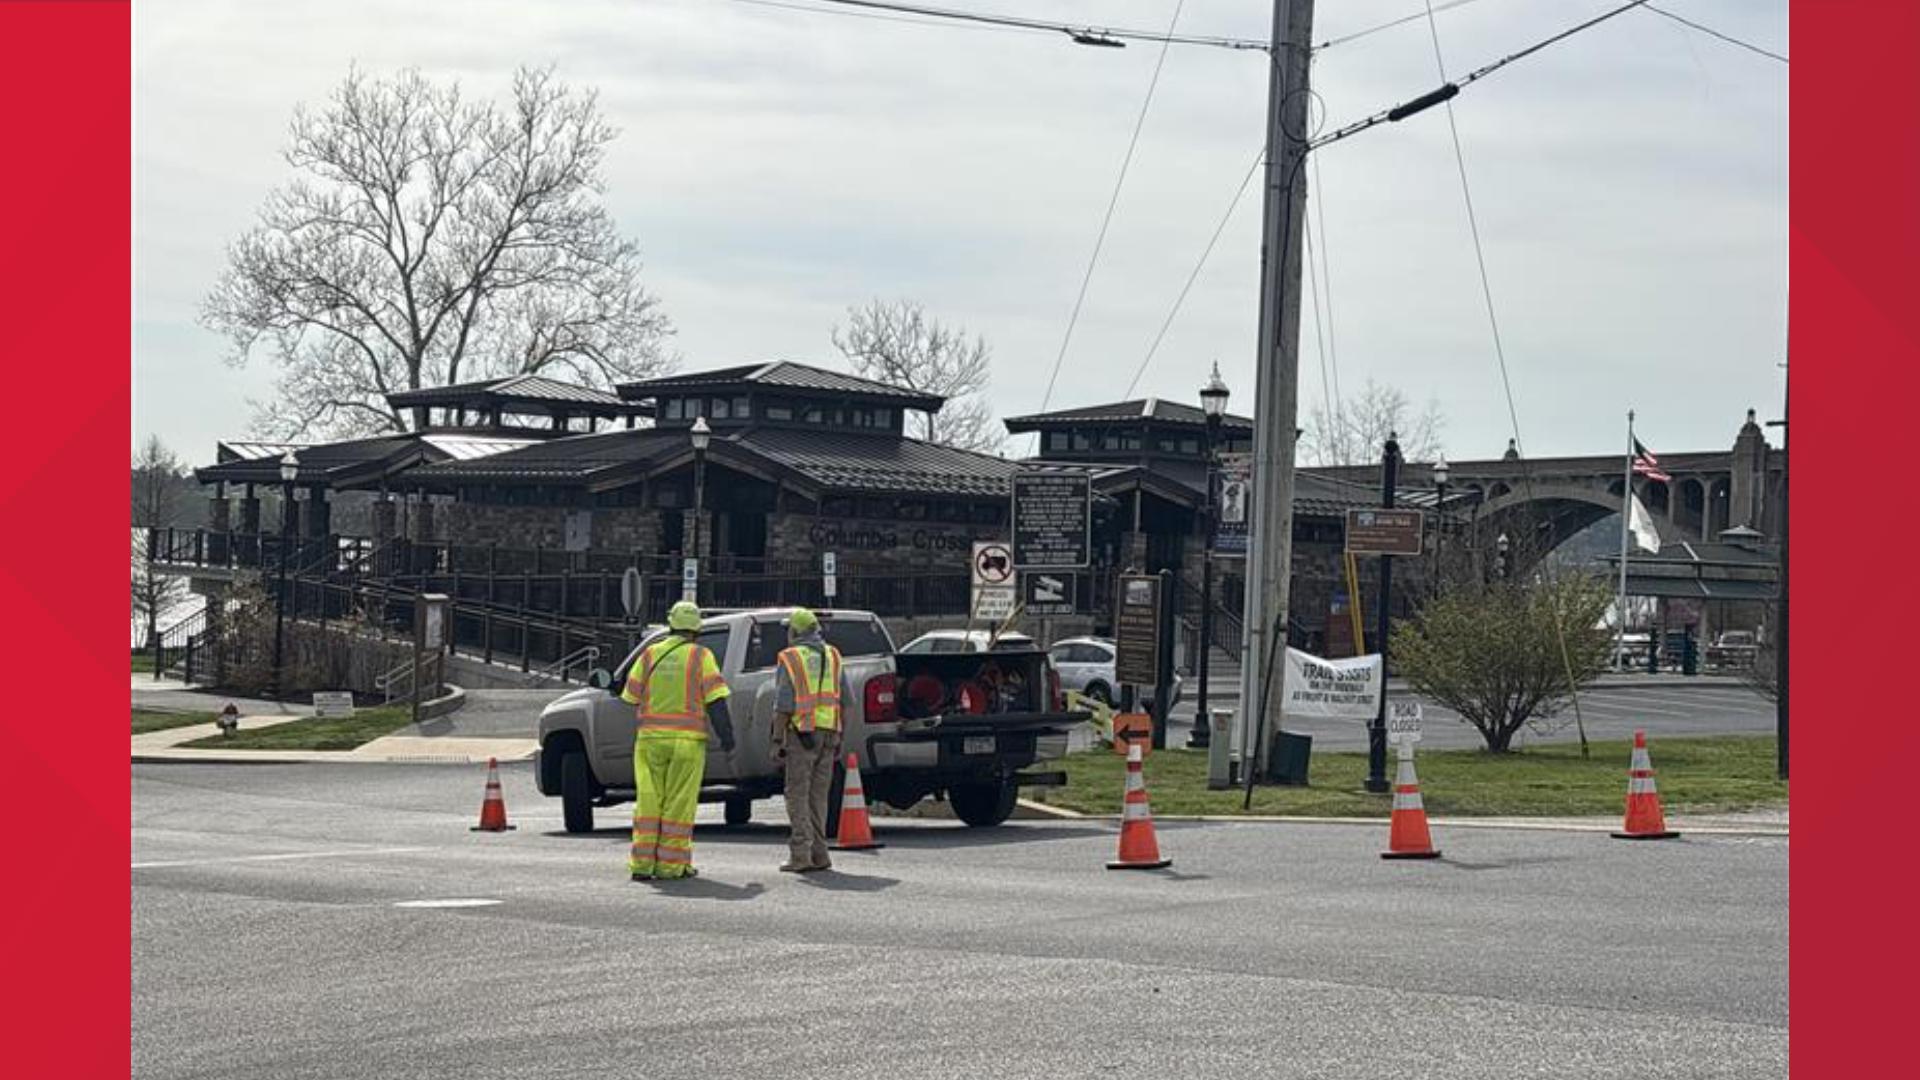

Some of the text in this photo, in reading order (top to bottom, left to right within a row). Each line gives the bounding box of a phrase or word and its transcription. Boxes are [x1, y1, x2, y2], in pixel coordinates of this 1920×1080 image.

[809, 522, 972, 552] Columbia Cross
[1302, 662, 1334, 681] TRAIL
[1394, 703, 1418, 717] ROAD
[1390, 719, 1421, 733] CLOSED
